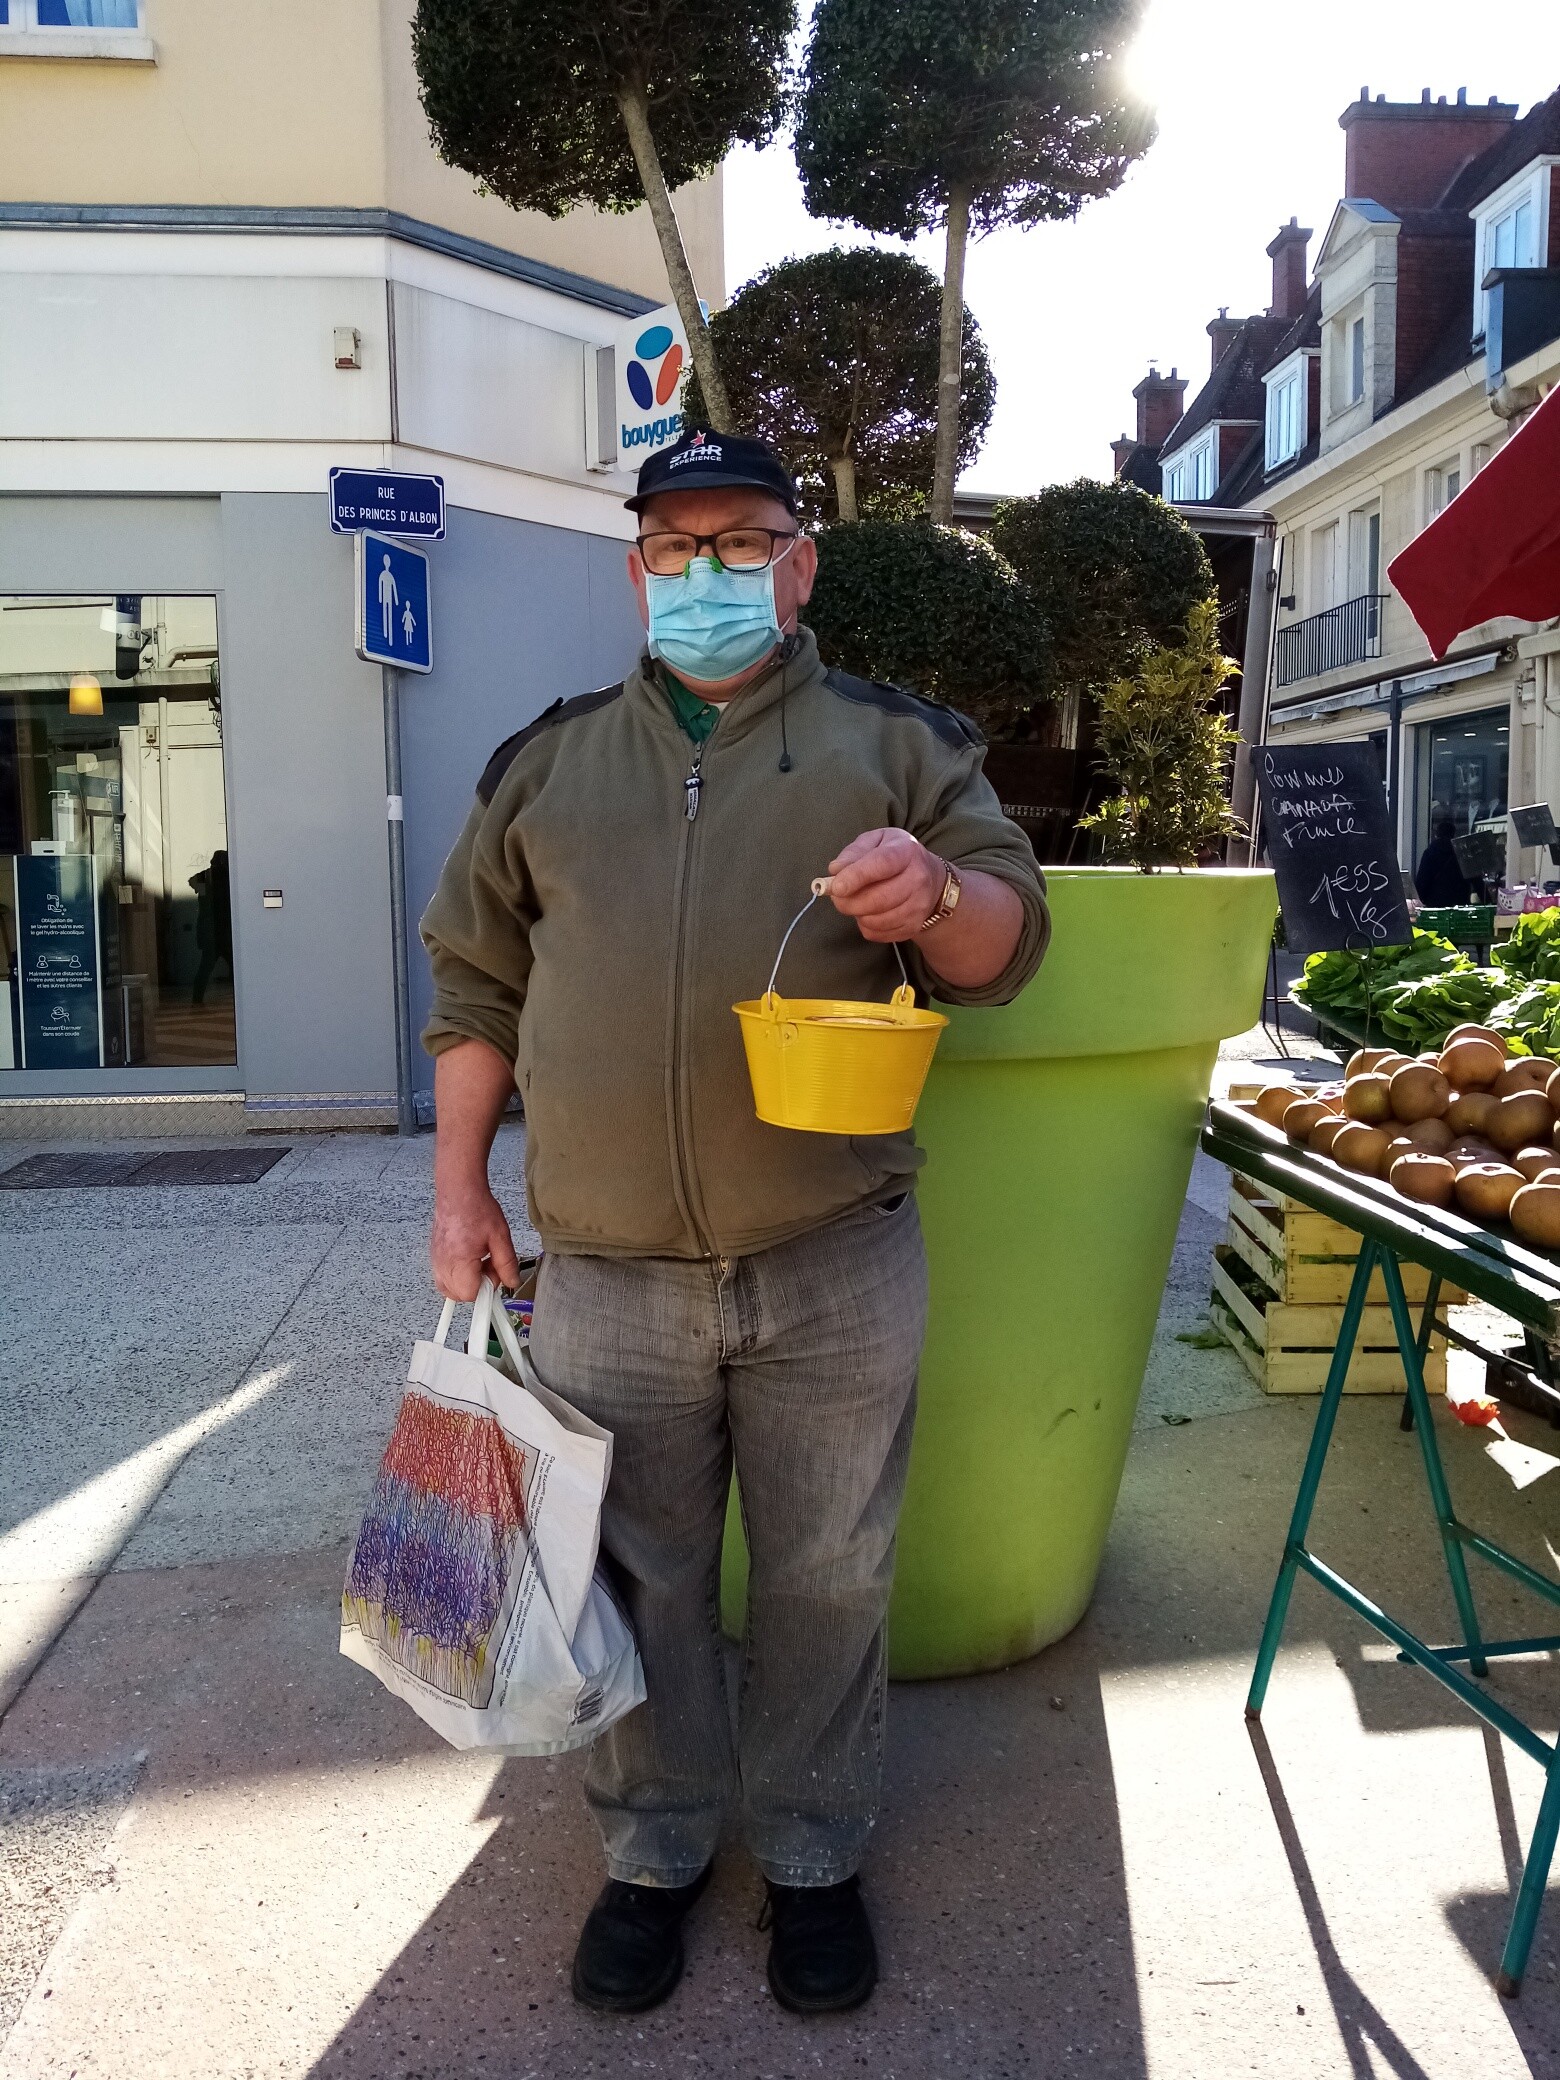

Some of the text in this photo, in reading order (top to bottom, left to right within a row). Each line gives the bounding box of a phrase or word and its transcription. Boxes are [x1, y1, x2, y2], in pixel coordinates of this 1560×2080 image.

[670, 445, 722, 464] STAR
[670, 456, 722, 469] EXPERIENCE
[378, 487, 395, 499] RUE
[338, 506, 438, 524] DES PRINCES D'ALBON
